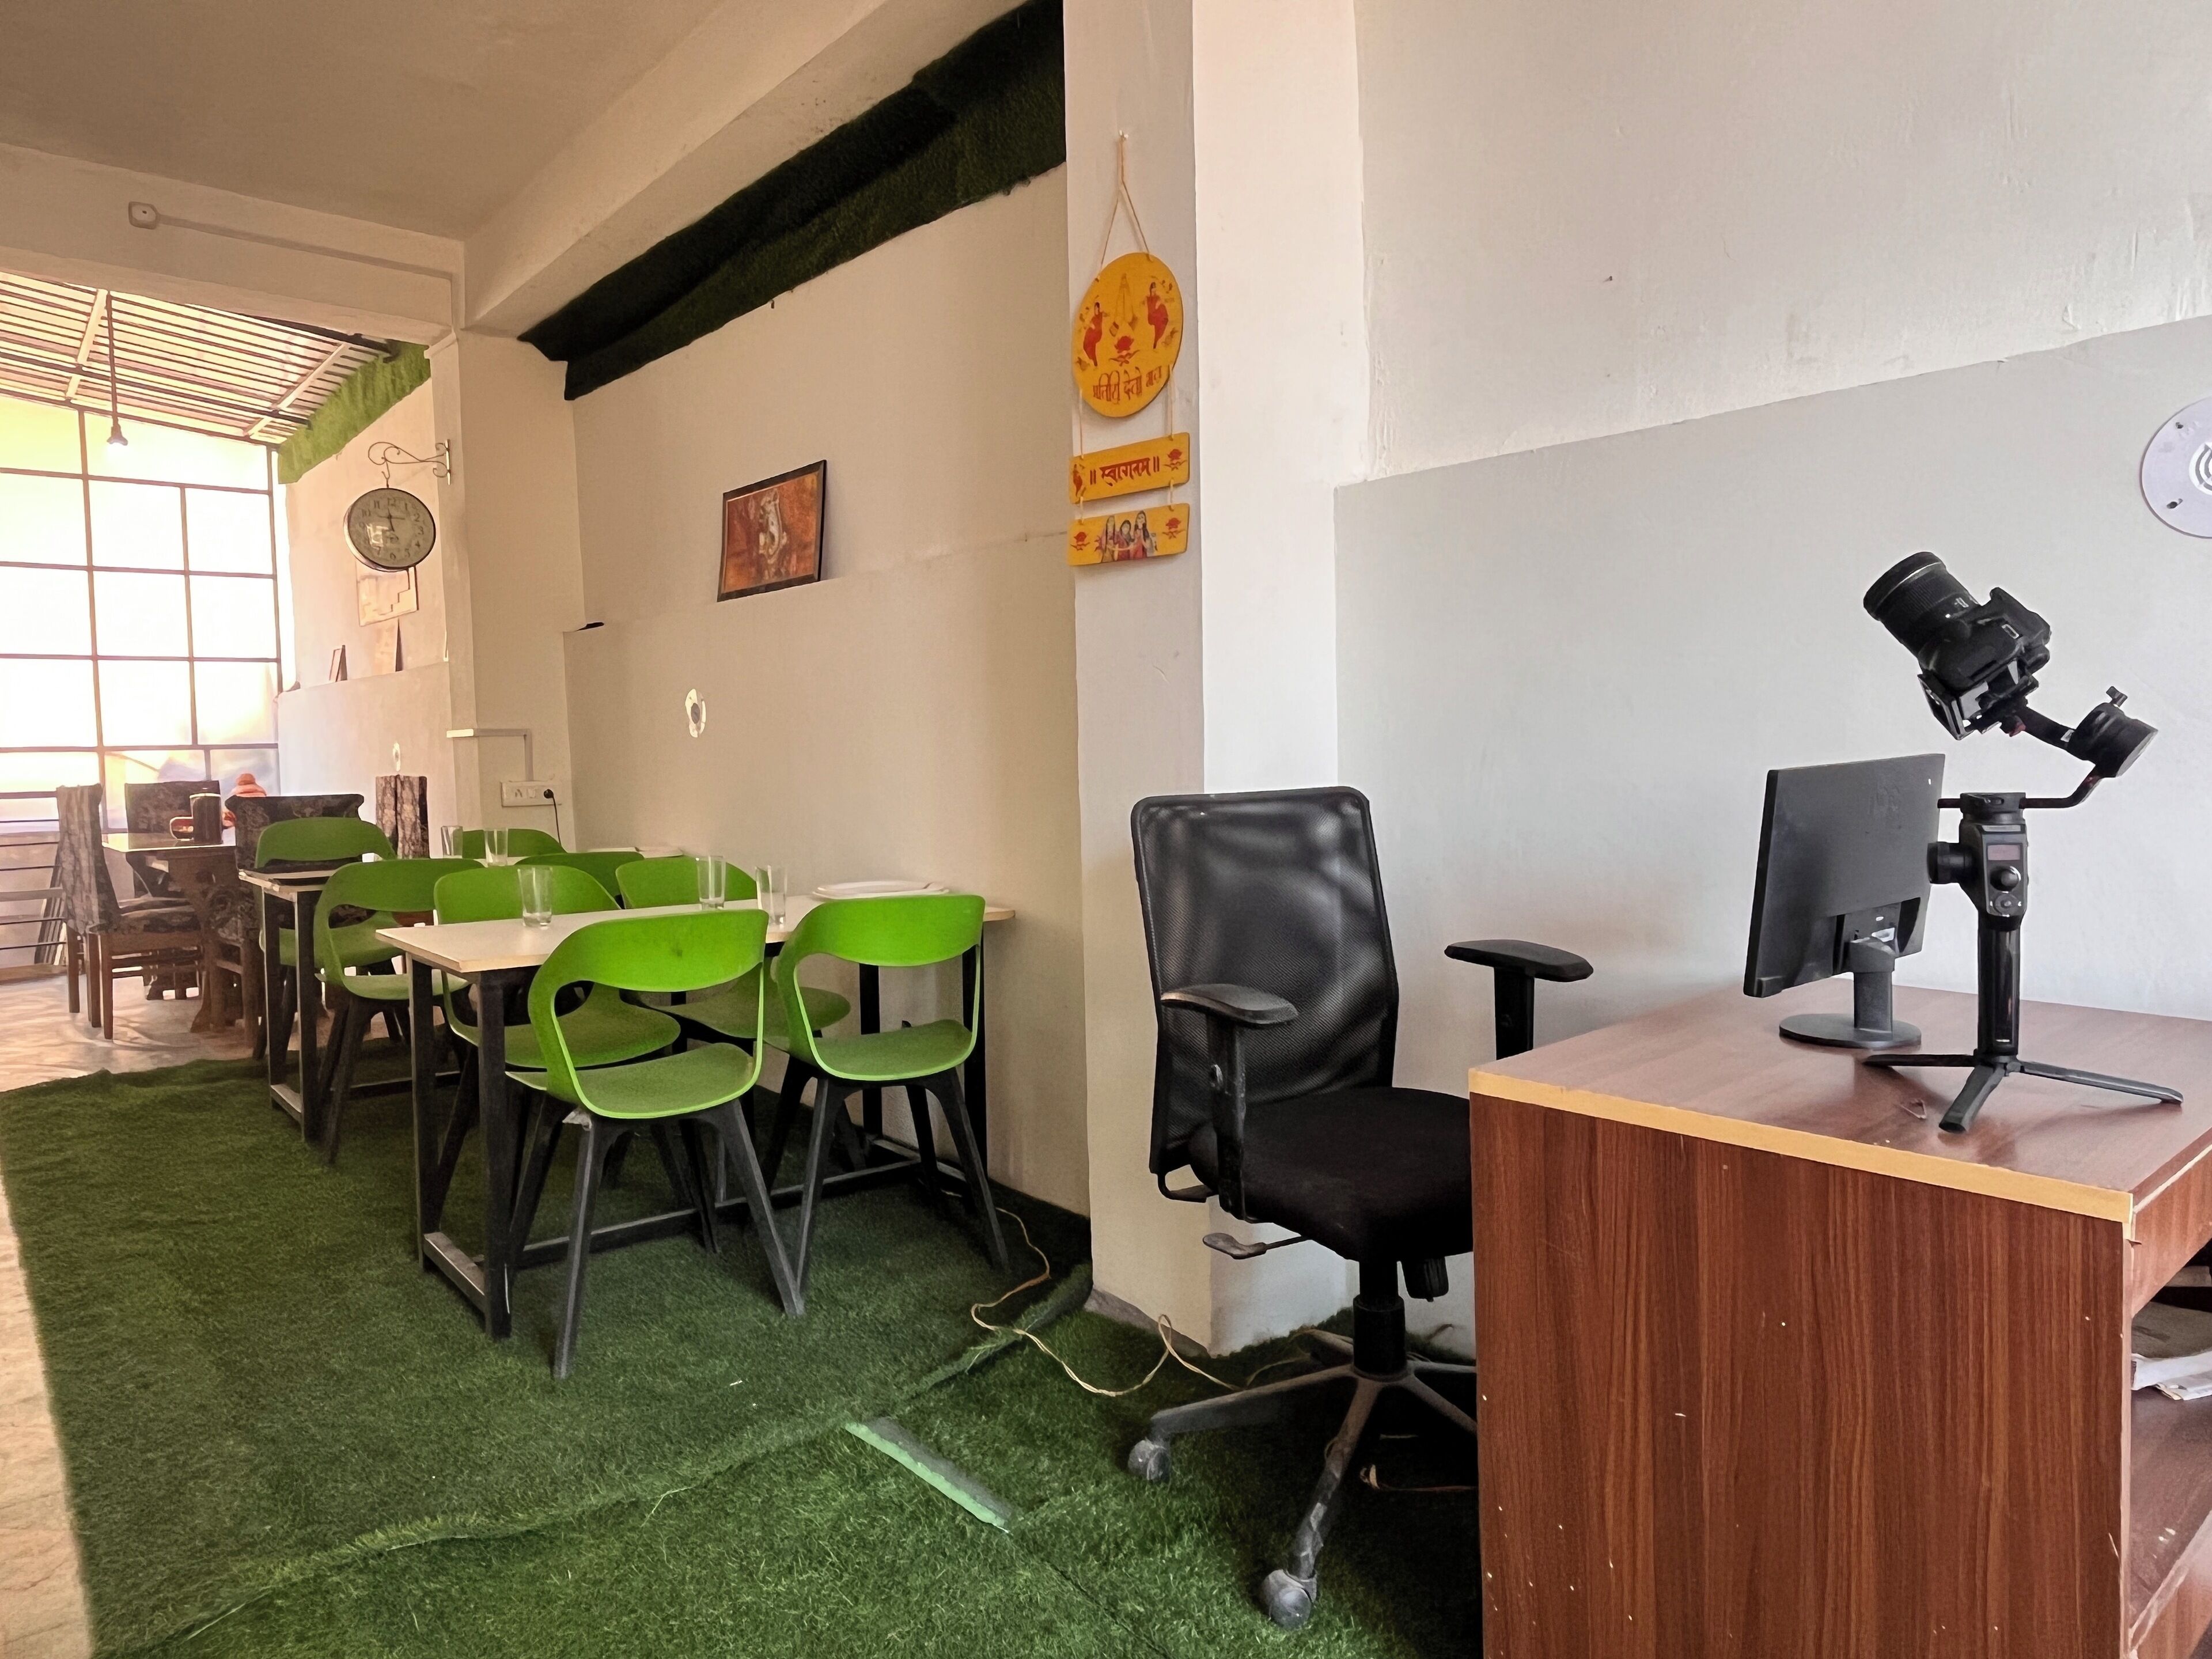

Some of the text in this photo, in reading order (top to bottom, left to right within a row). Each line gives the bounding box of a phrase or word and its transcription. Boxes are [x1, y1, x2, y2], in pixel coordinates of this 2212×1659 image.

[374, 500, 380, 509] 11
[414, 513, 420, 522] 2
[418, 526, 424, 535] 3
